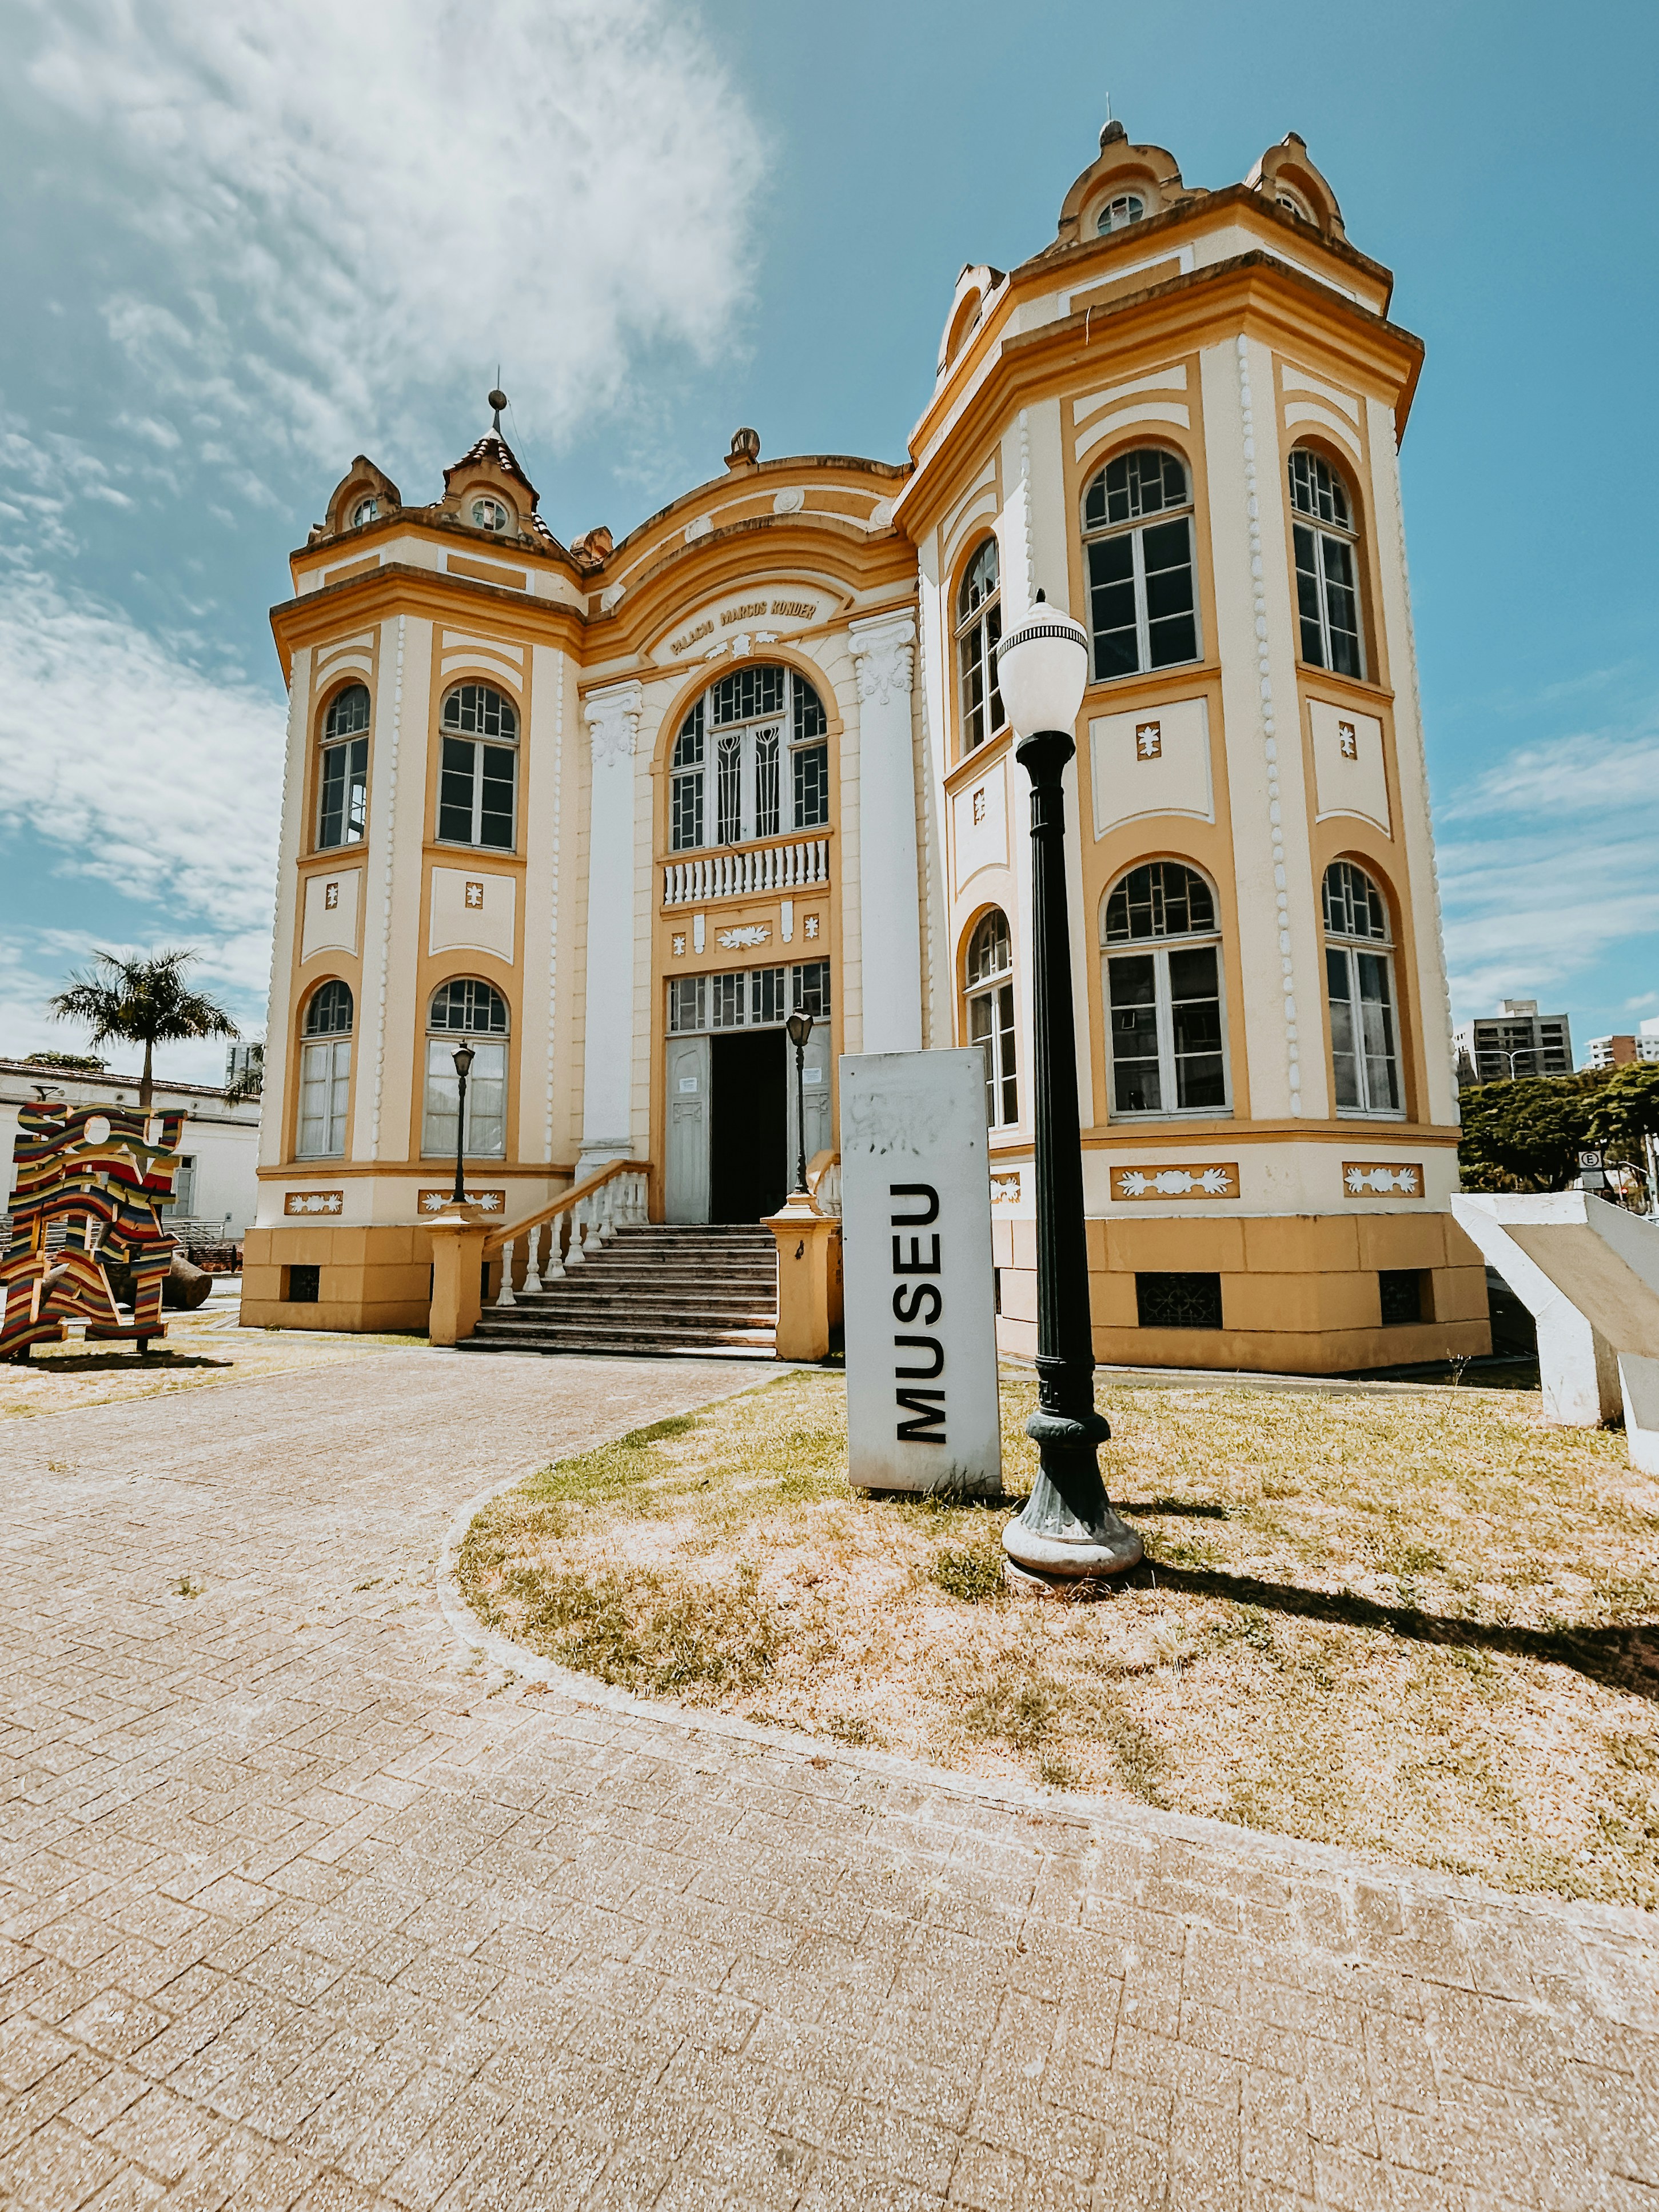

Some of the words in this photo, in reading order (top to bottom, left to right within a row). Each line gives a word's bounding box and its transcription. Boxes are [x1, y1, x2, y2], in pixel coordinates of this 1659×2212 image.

[670, 620, 714, 656] PALACIO
[720, 601, 767, 626] MARCOS
[771, 600, 816, 620] KONDER
[1586, 1155, 1593, 1164] E
[890, 1182, 947, 1444] MUSEU
